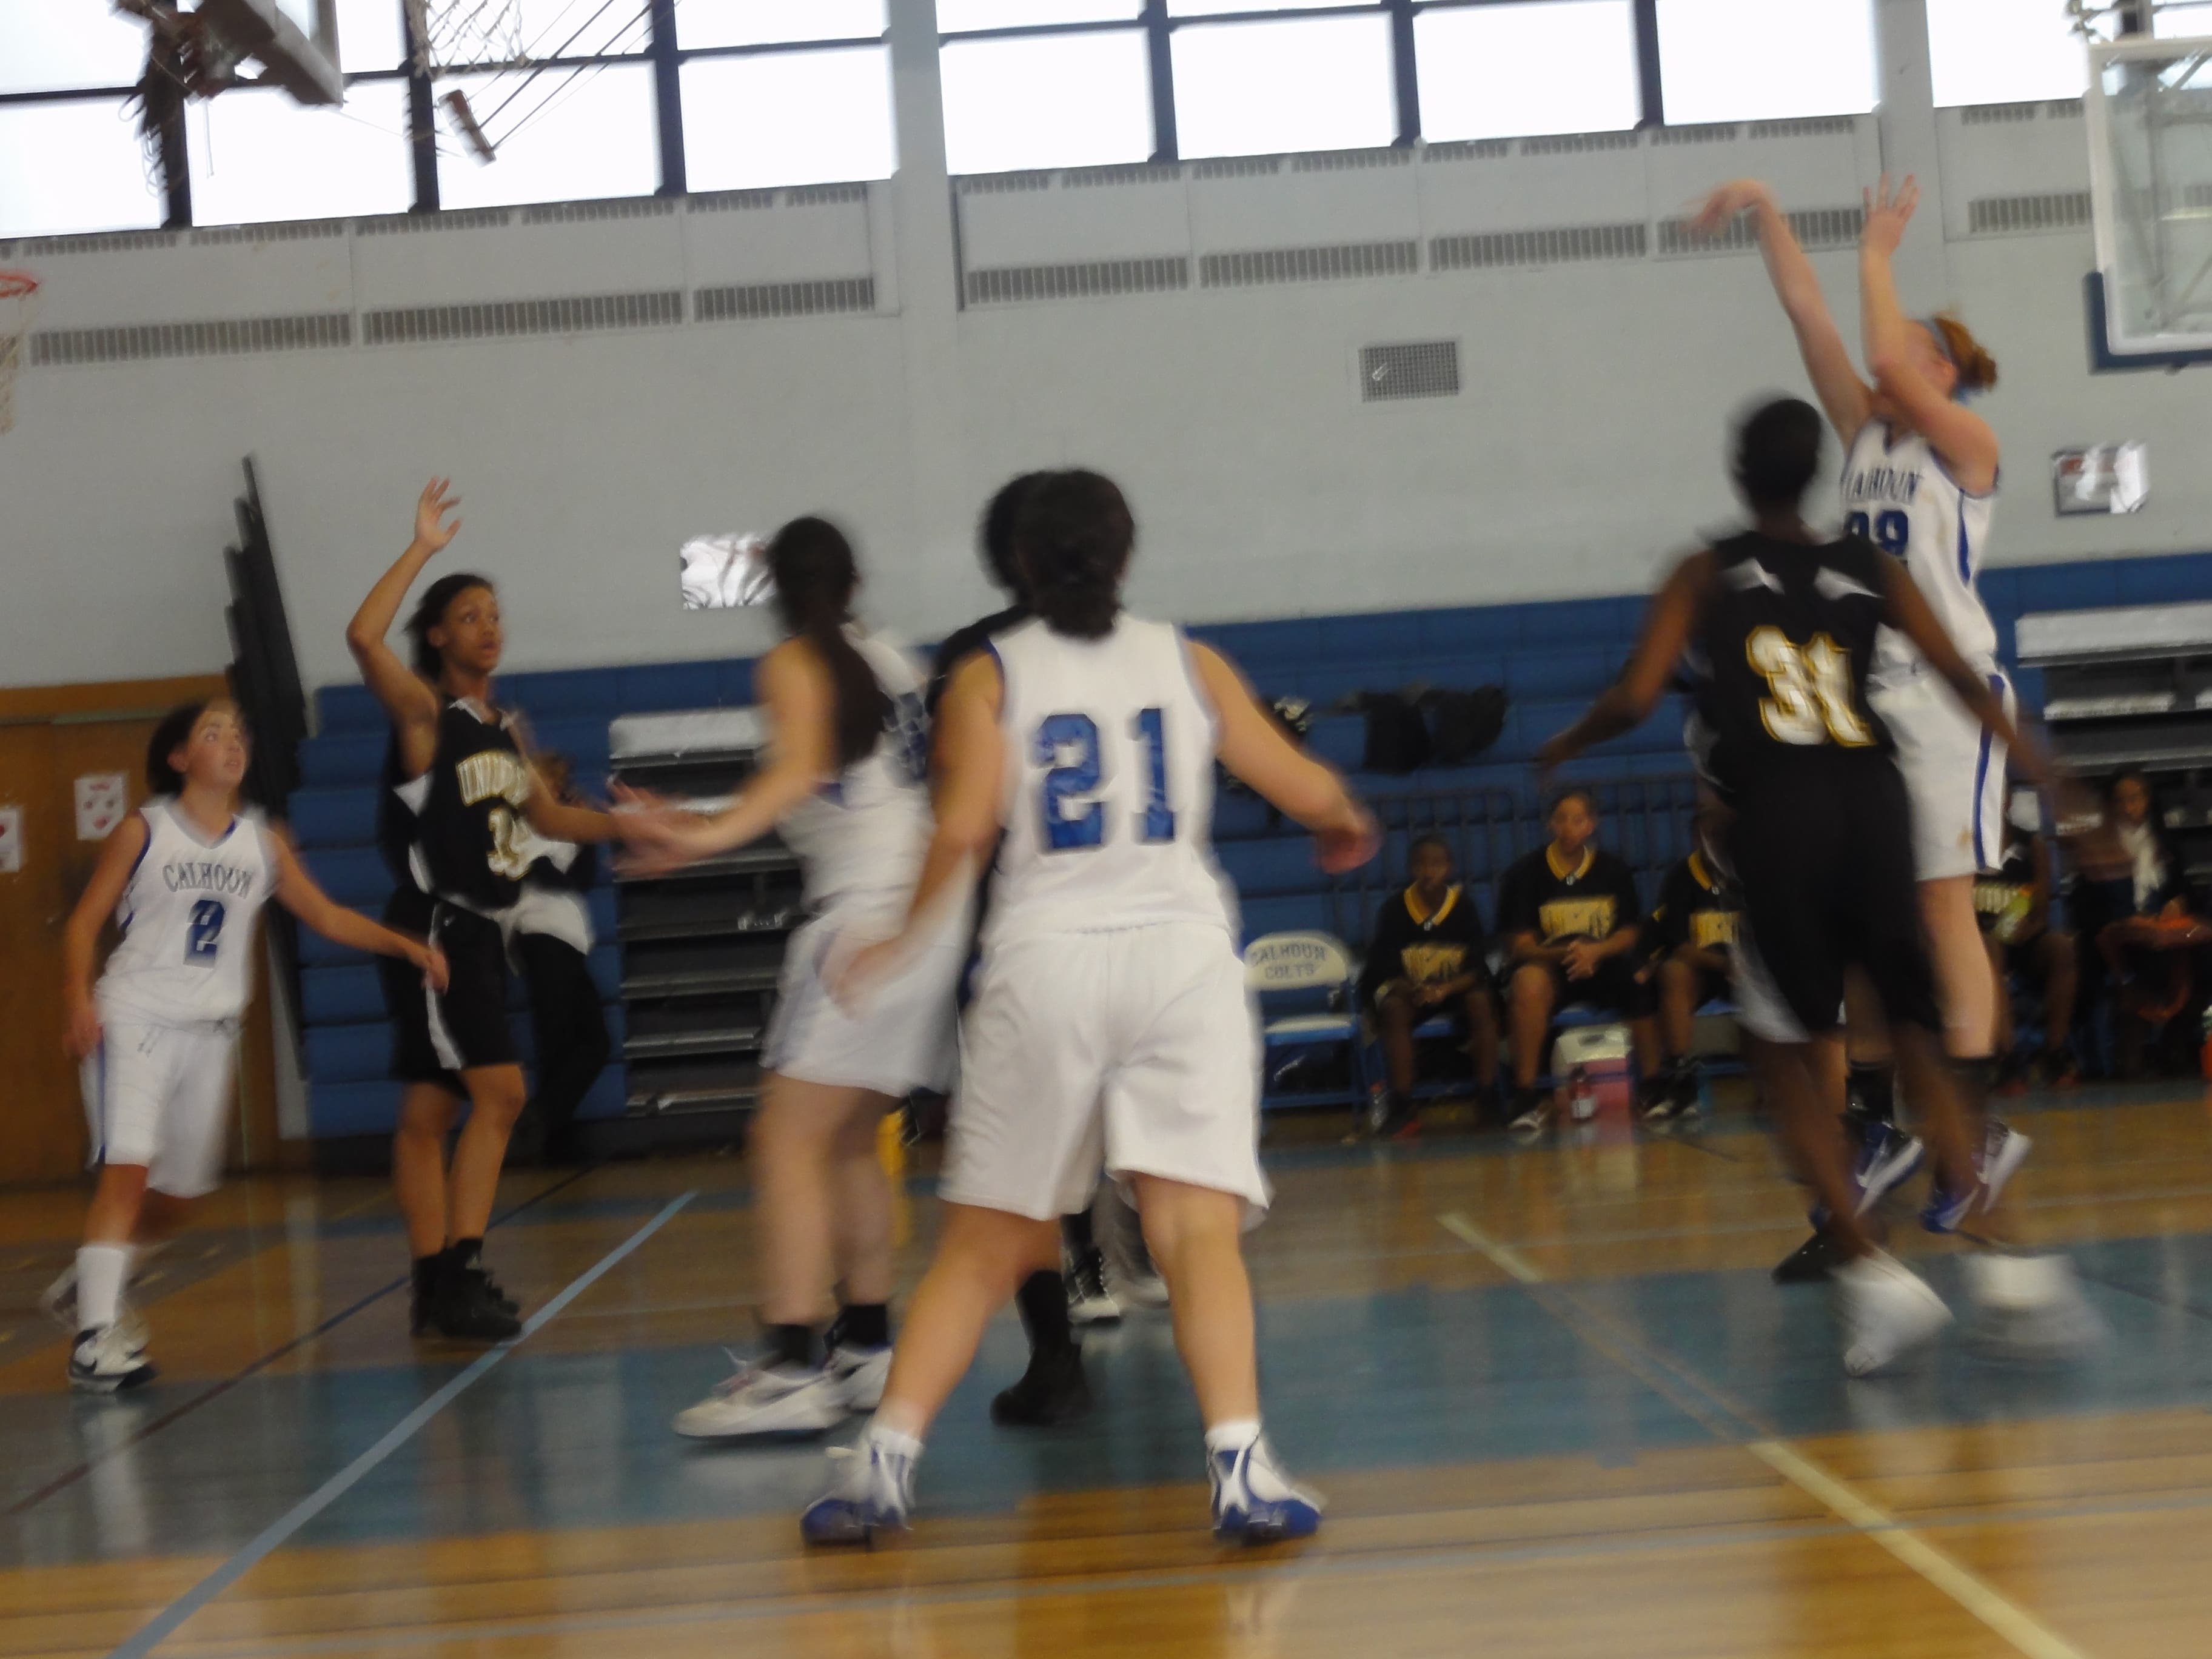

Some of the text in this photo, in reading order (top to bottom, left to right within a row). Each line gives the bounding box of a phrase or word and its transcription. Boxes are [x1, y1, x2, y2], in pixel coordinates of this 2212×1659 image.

[1034, 707, 1175, 850] 21
[162, 862, 252, 900] CALHOUN
[184, 899, 227, 969] 2
